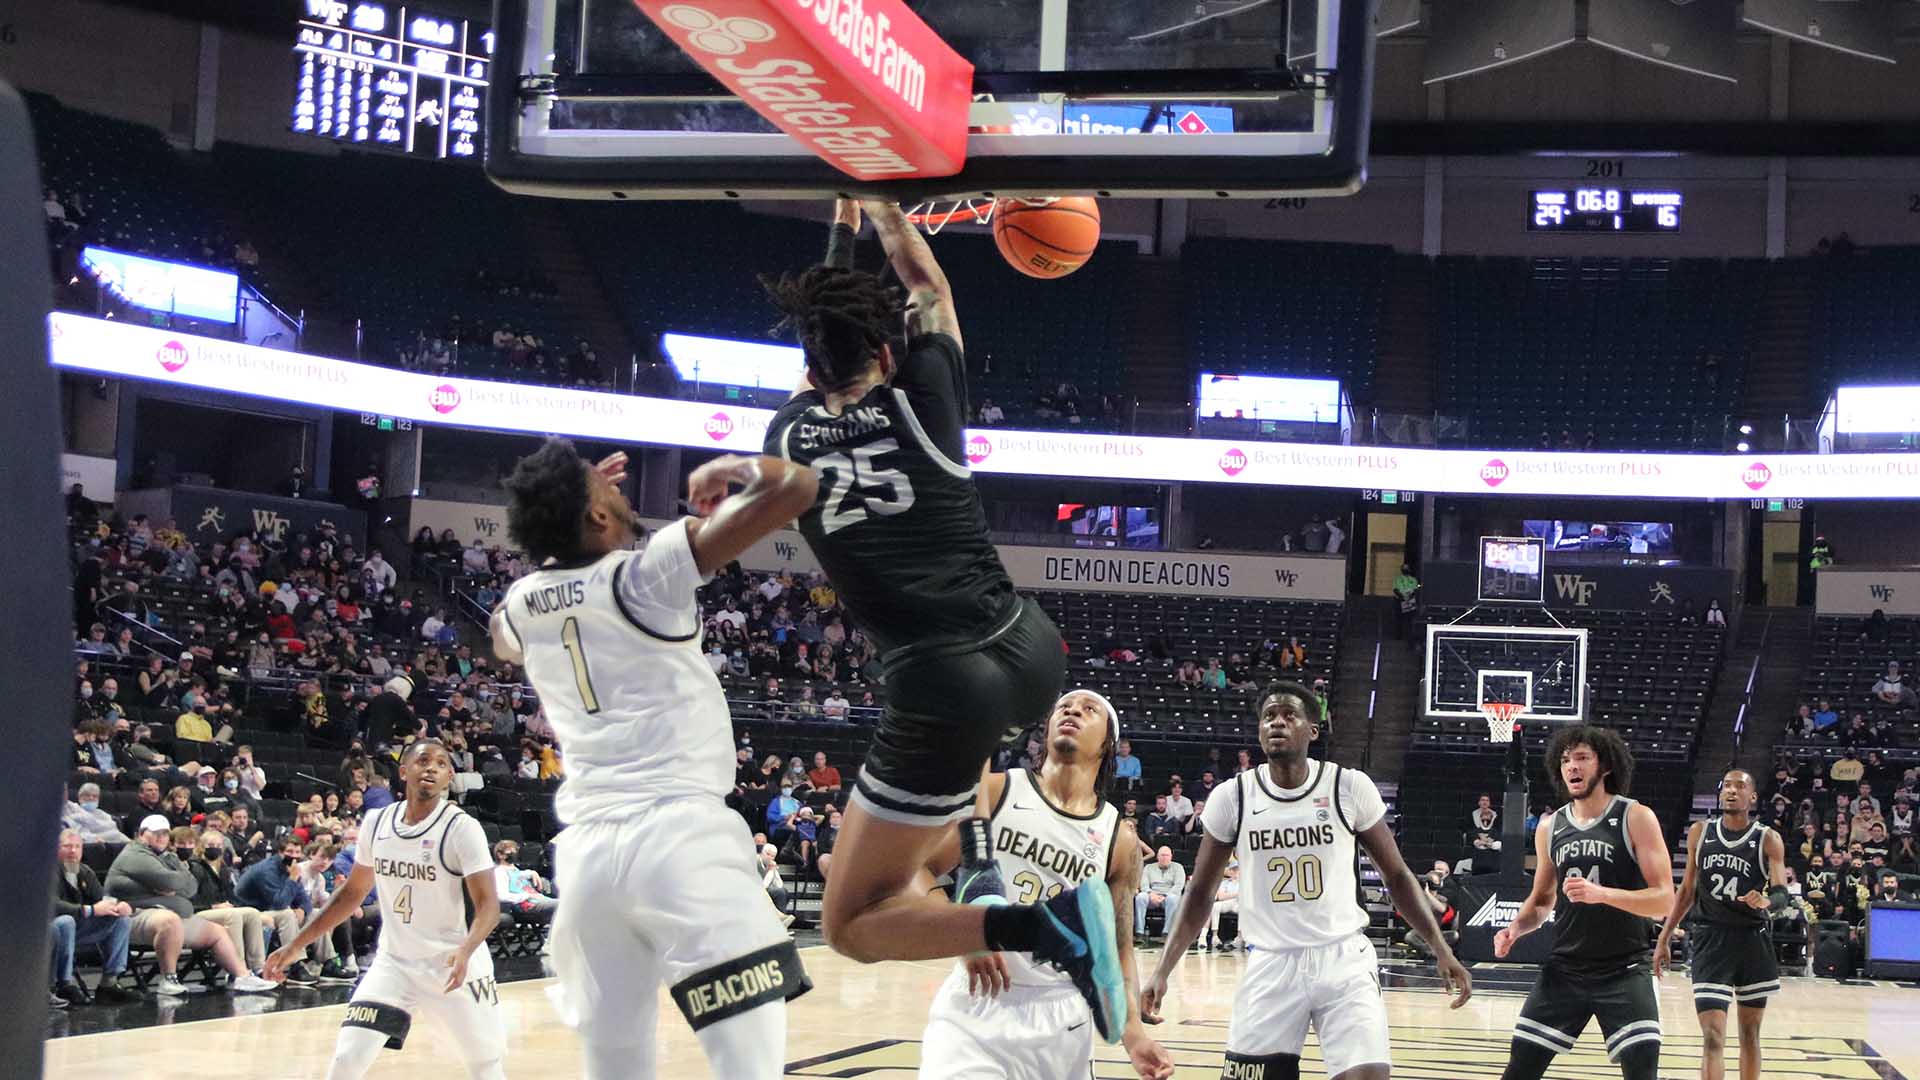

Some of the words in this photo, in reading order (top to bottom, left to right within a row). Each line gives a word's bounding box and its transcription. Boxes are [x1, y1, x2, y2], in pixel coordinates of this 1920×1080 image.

[1587, 160, 1624, 177] 201
[1576, 190, 1619, 211] 06.8
[1535, 205, 1562, 225] 29
[1658, 206, 1677, 226] 16
[1103, 441, 1144, 457] PLUS
[1218, 455, 1247, 470] BW
[1254, 450, 1286, 465] Best
[1358, 455, 1398, 470] PLUS
[1481, 464, 1508, 480] BW
[1516, 459, 1550, 474] Best
[1619, 462, 1662, 477] PLUS
[1743, 470, 1770, 483] BW
[1886, 461, 1920, 476] PLU
[811, 437, 917, 536] 25
[1363, 489, 1378, 500] 124
[1401, 491, 1415, 502] 101
[1751, 498, 1765, 509] 101
[1787, 498, 1804, 509] 102
[252, 509, 290, 542] WF
[474, 516, 500, 537] WF
[774, 541, 798, 561] WF
[1045, 556, 1122, 583] DEMON
[1127, 560, 1231, 588] DEACONS
[1274, 568, 1299, 587] WF
[523, 580, 585, 617] MUCIUS
[1552, 573, 1597, 607] WF
[1869, 584, 1895, 602] WF
[561, 616, 600, 714] 1
[1248, 824, 1335, 852] DEACONS
[996, 826, 1097, 884] DEACONS
[1555, 839, 1615, 868] UPSTATE
[1702, 853, 1752, 878] UPSTATE
[374, 856, 437, 882] DEACONS
[1266, 853, 1325, 904] 20
[1710, 873, 1739, 902] 24
[393, 884, 414, 924] 4
[687, 959, 785, 1017] DEACONS
[346, 1006, 379, 1024] EMON
